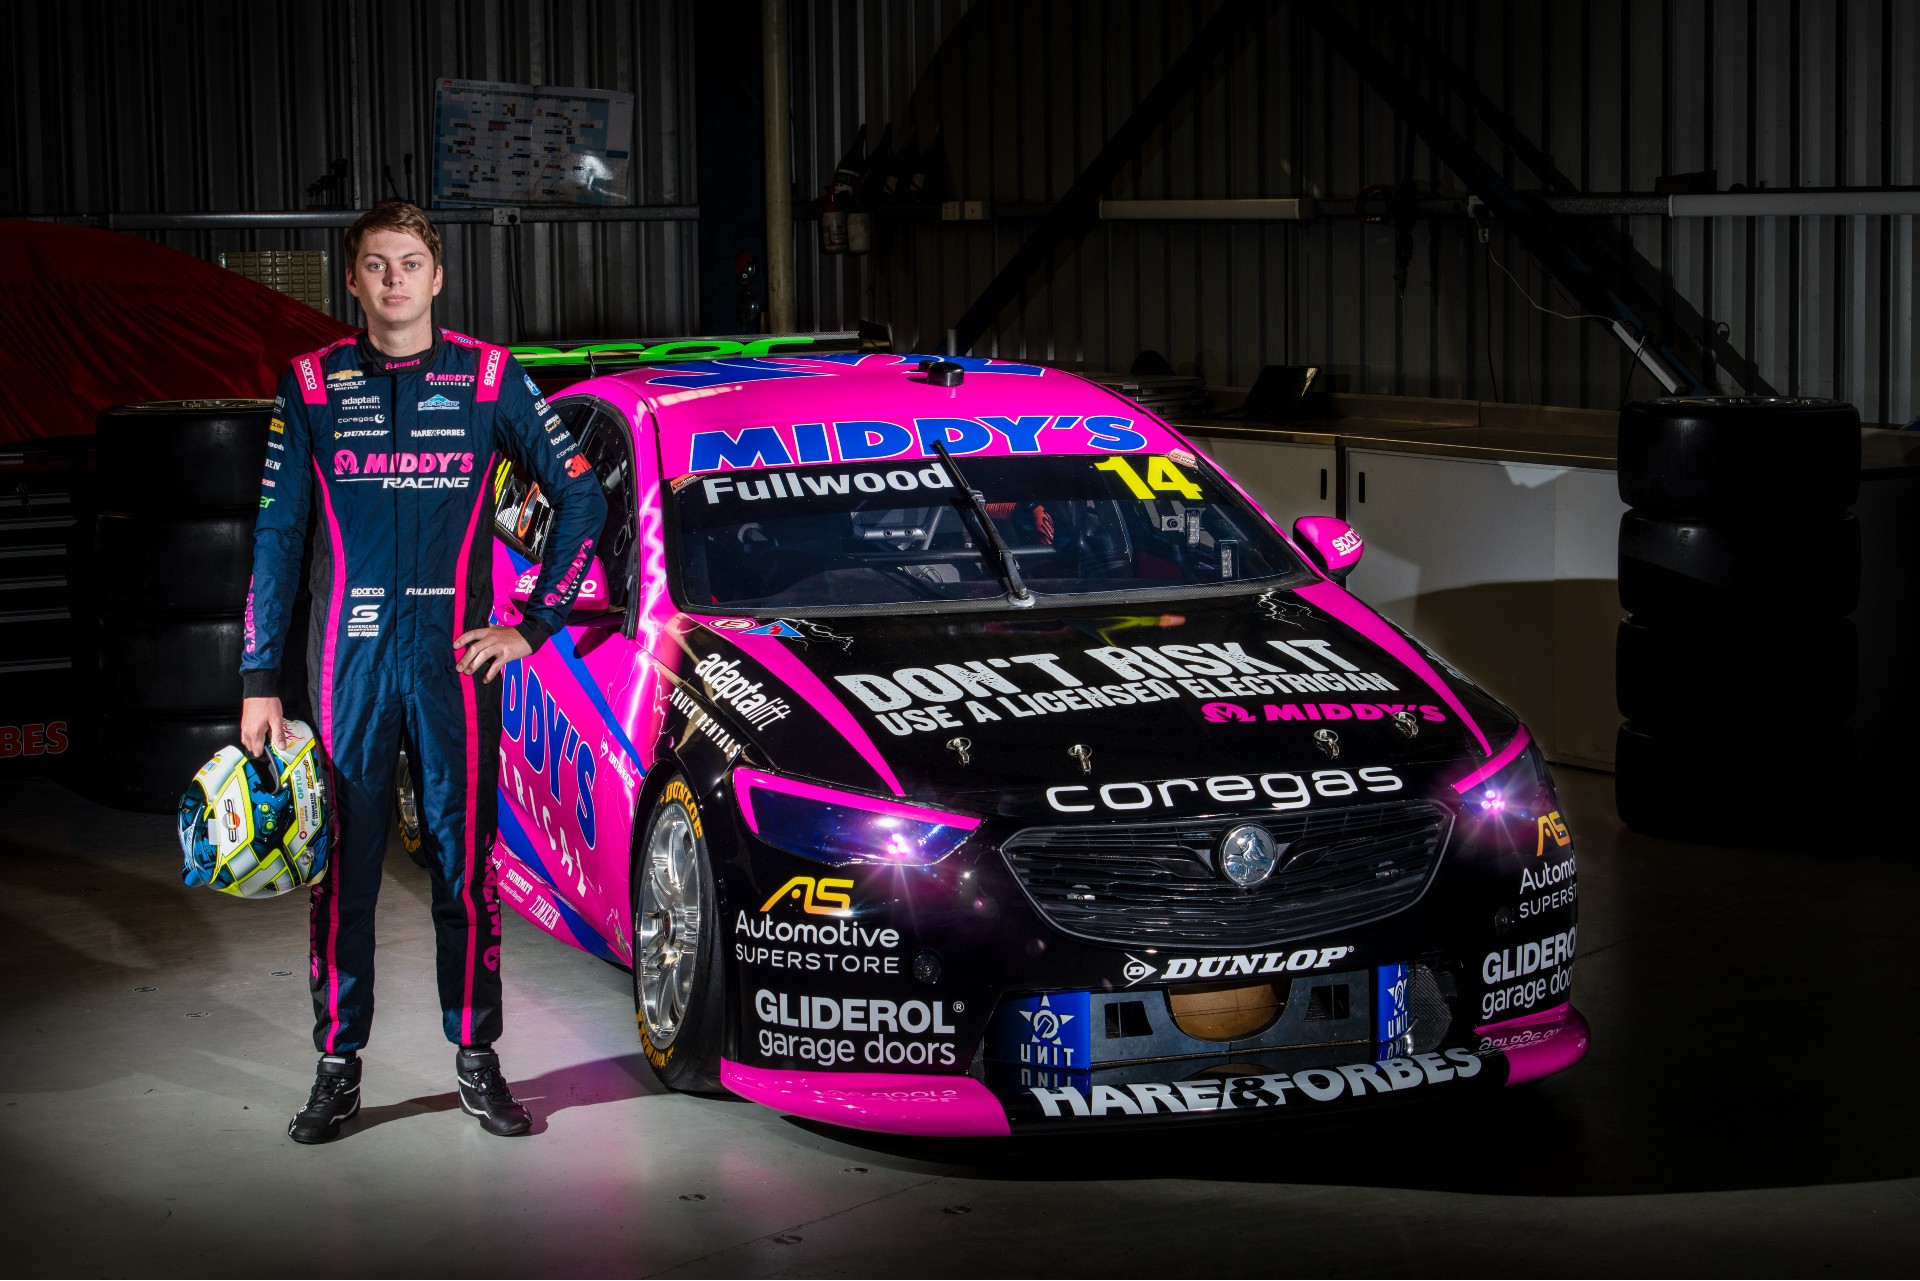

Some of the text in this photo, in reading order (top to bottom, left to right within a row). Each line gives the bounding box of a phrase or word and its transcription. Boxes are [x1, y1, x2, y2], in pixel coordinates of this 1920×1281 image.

[300, 358, 318, 391] sparco
[327, 381, 367, 389] CHEVROLET
[437, 374, 475, 382] MIDDY'S
[483, 349, 501, 387] sparco
[343, 430, 389, 438] DUNLOP
[689, 414, 1148, 473] MIDDY'S
[363, 453, 475, 474] MIDDY'S
[565, 452, 592, 479] 3M
[1095, 456, 1203, 500] 14
[382, 477, 470, 489] RACING
[703, 463, 954, 505] Fullwood
[555, 537, 594, 595] MIDDY'S
[351, 587, 385, 597] sparco
[405, 588, 456, 596] FULLWOOD
[694, 653, 792, 732] adaptalift
[836, 653, 1082, 712] DON'T
[1083, 640, 1280, 688] RISK
[1271, 640, 1361, 673] IT
[876, 664, 1400, 736] USE A LICENSED ELECTRICIAN
[1267, 703, 1446, 722] MIDDY'S
[669, 688, 742, 758] TRUCK RENTALS
[502, 656, 596, 851] DDY'S
[608, 751, 635, 789] DUNLOP
[294, 769, 304, 800] OPTUS
[1047, 766, 1403, 812] coregas
[666, 781, 703, 838] DUNLOP
[1536, 811, 1571, 857] AS
[506, 869, 533, 895] SUMMIT
[760, 876, 854, 914] AS
[528, 895, 561, 931] TIMKEN
[735, 910, 900, 948] Automotive
[736, 943, 900, 974] SUPERSTORE
[1161, 946, 1349, 980] DUNLOP
[755, 988, 956, 1034] GLIDEROL
[1482, 978, 1547, 1020] garage
[758, 1029, 956, 1067] garage doors
